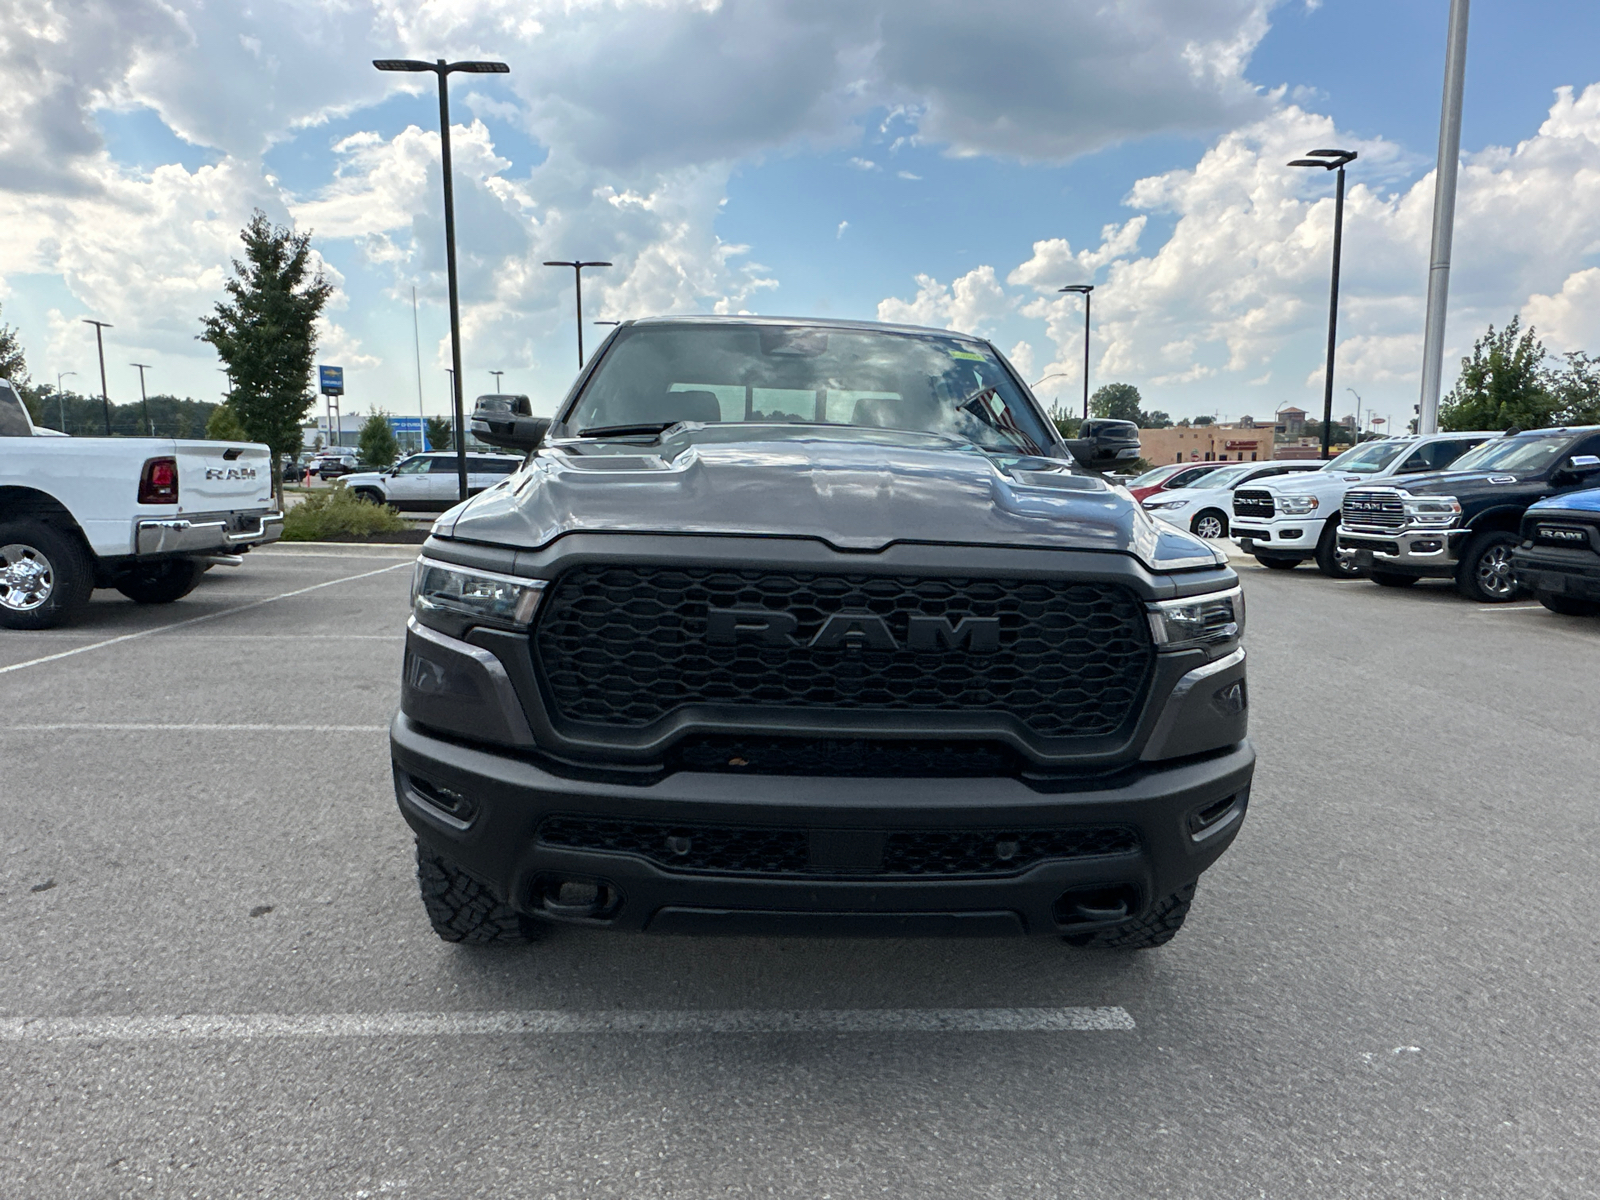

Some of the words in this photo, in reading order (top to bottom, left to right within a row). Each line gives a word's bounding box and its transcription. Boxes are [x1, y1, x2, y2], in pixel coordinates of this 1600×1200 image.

[205, 466, 257, 480] RAM
[1352, 502, 1381, 510] RAM
[1540, 530, 1582, 540] RAM
[707, 607, 1000, 651] RAM
